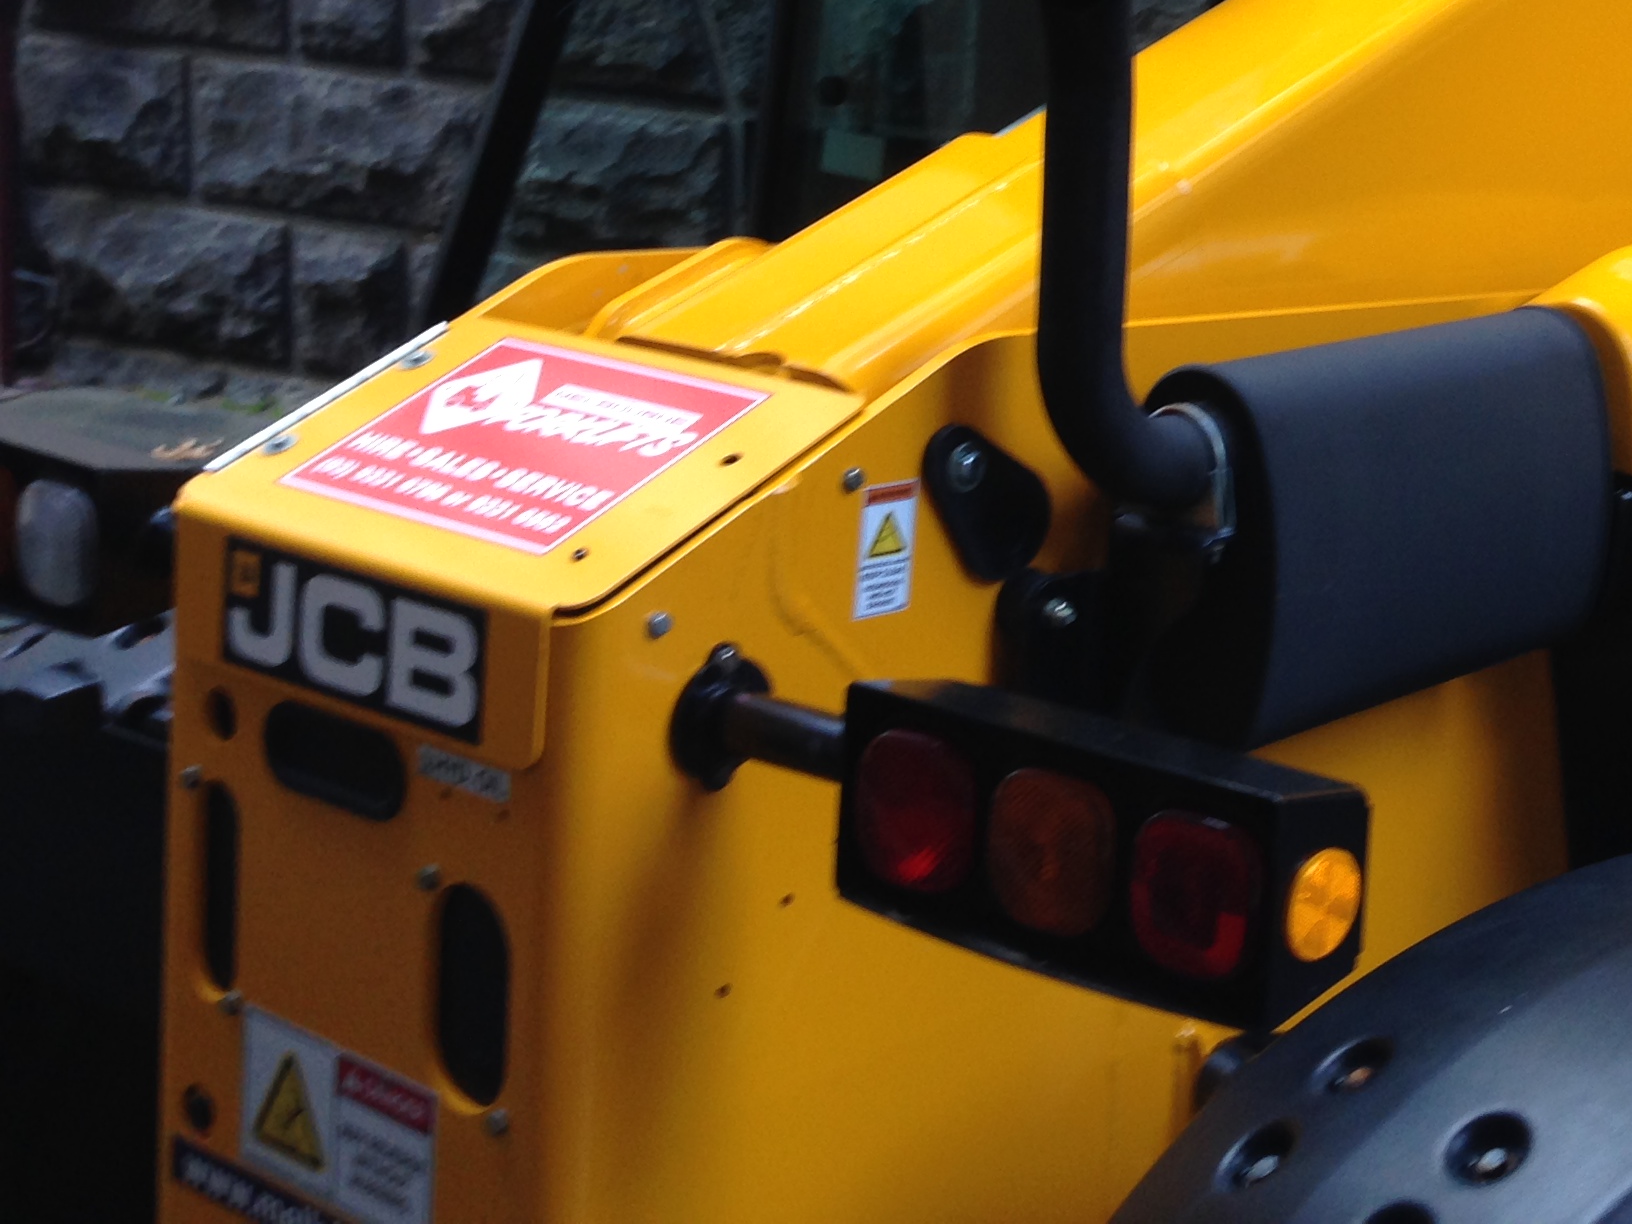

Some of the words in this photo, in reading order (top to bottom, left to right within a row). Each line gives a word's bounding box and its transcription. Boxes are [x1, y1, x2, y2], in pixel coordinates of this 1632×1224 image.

[345, 430, 409, 461] HIRE
[495, 467, 616, 512] SERVICE
[226, 562, 478, 726] JCB
